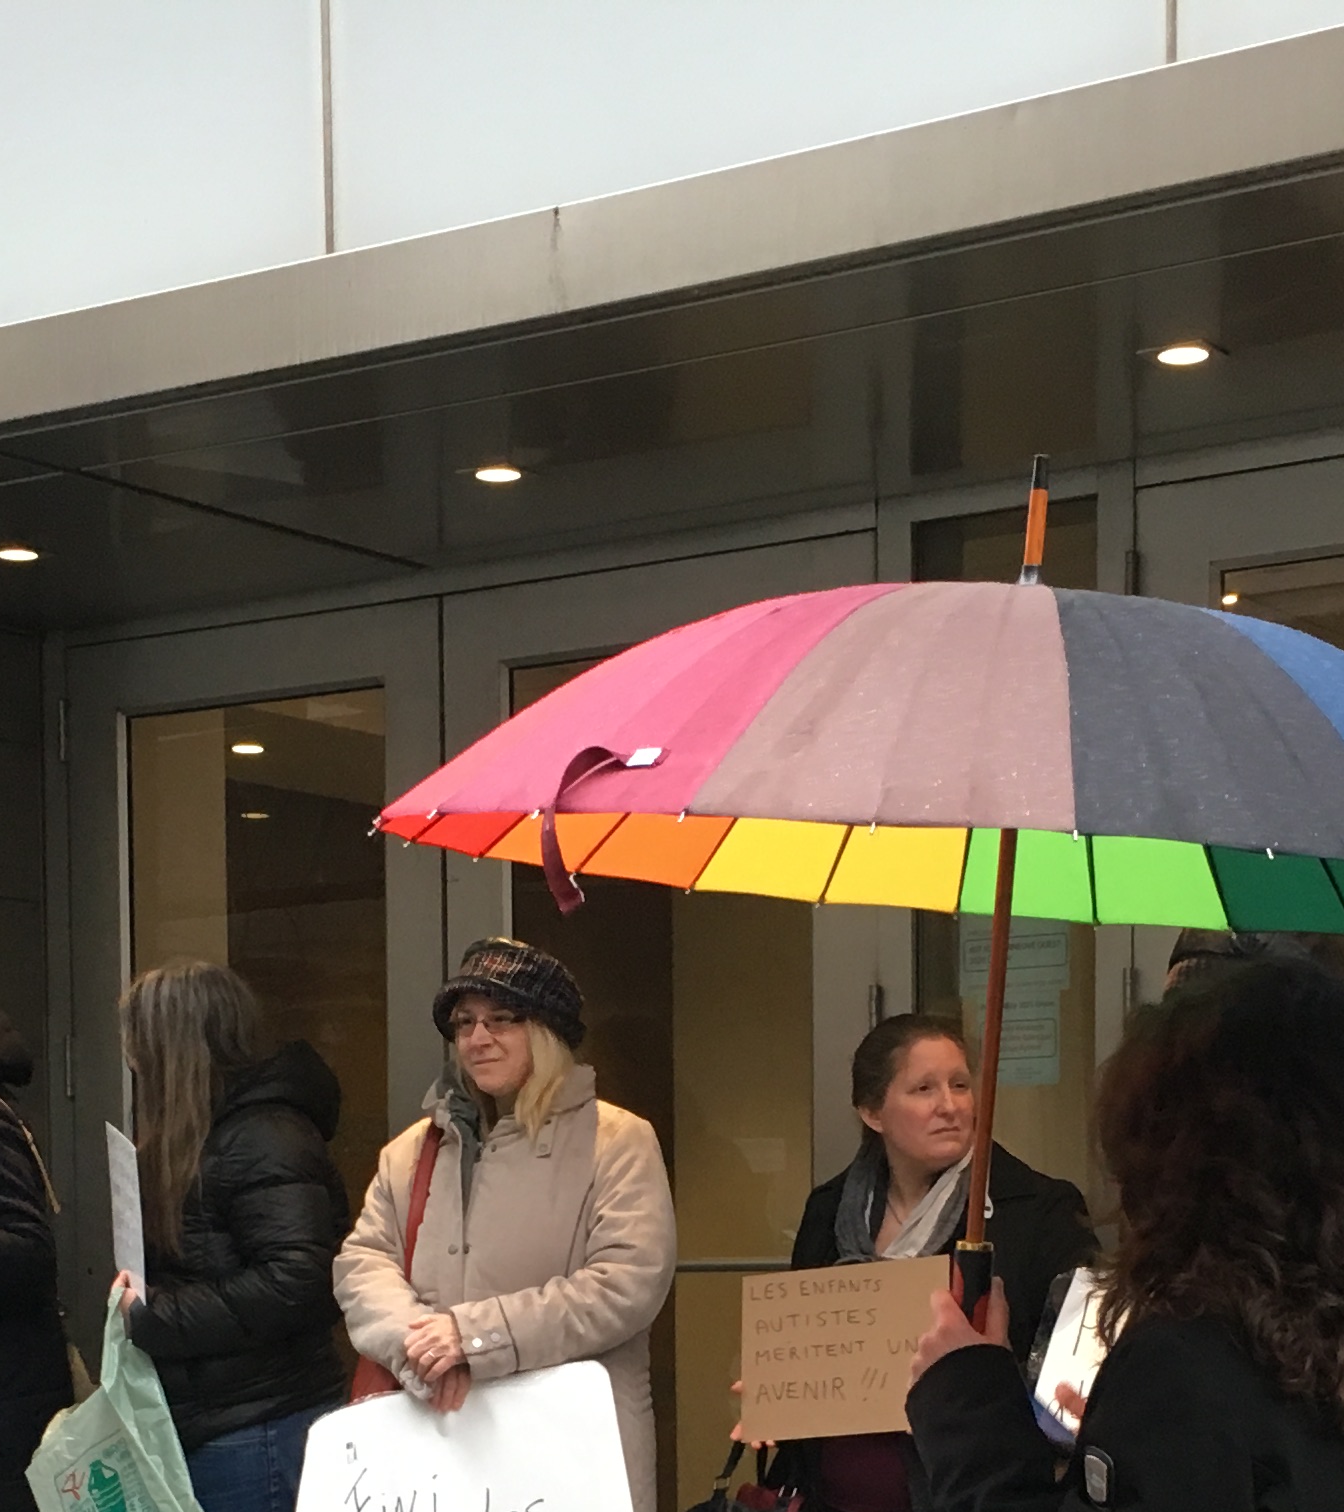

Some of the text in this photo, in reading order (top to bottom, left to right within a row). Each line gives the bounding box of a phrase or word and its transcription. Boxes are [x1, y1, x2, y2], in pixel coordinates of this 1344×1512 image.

[750, 1278, 882, 1301] LES ENFANTS
[756, 1307, 877, 1335] AUTISTES
[887, 1336, 919, 1355] UN
[756, 1376, 846, 1404] AVENIR
